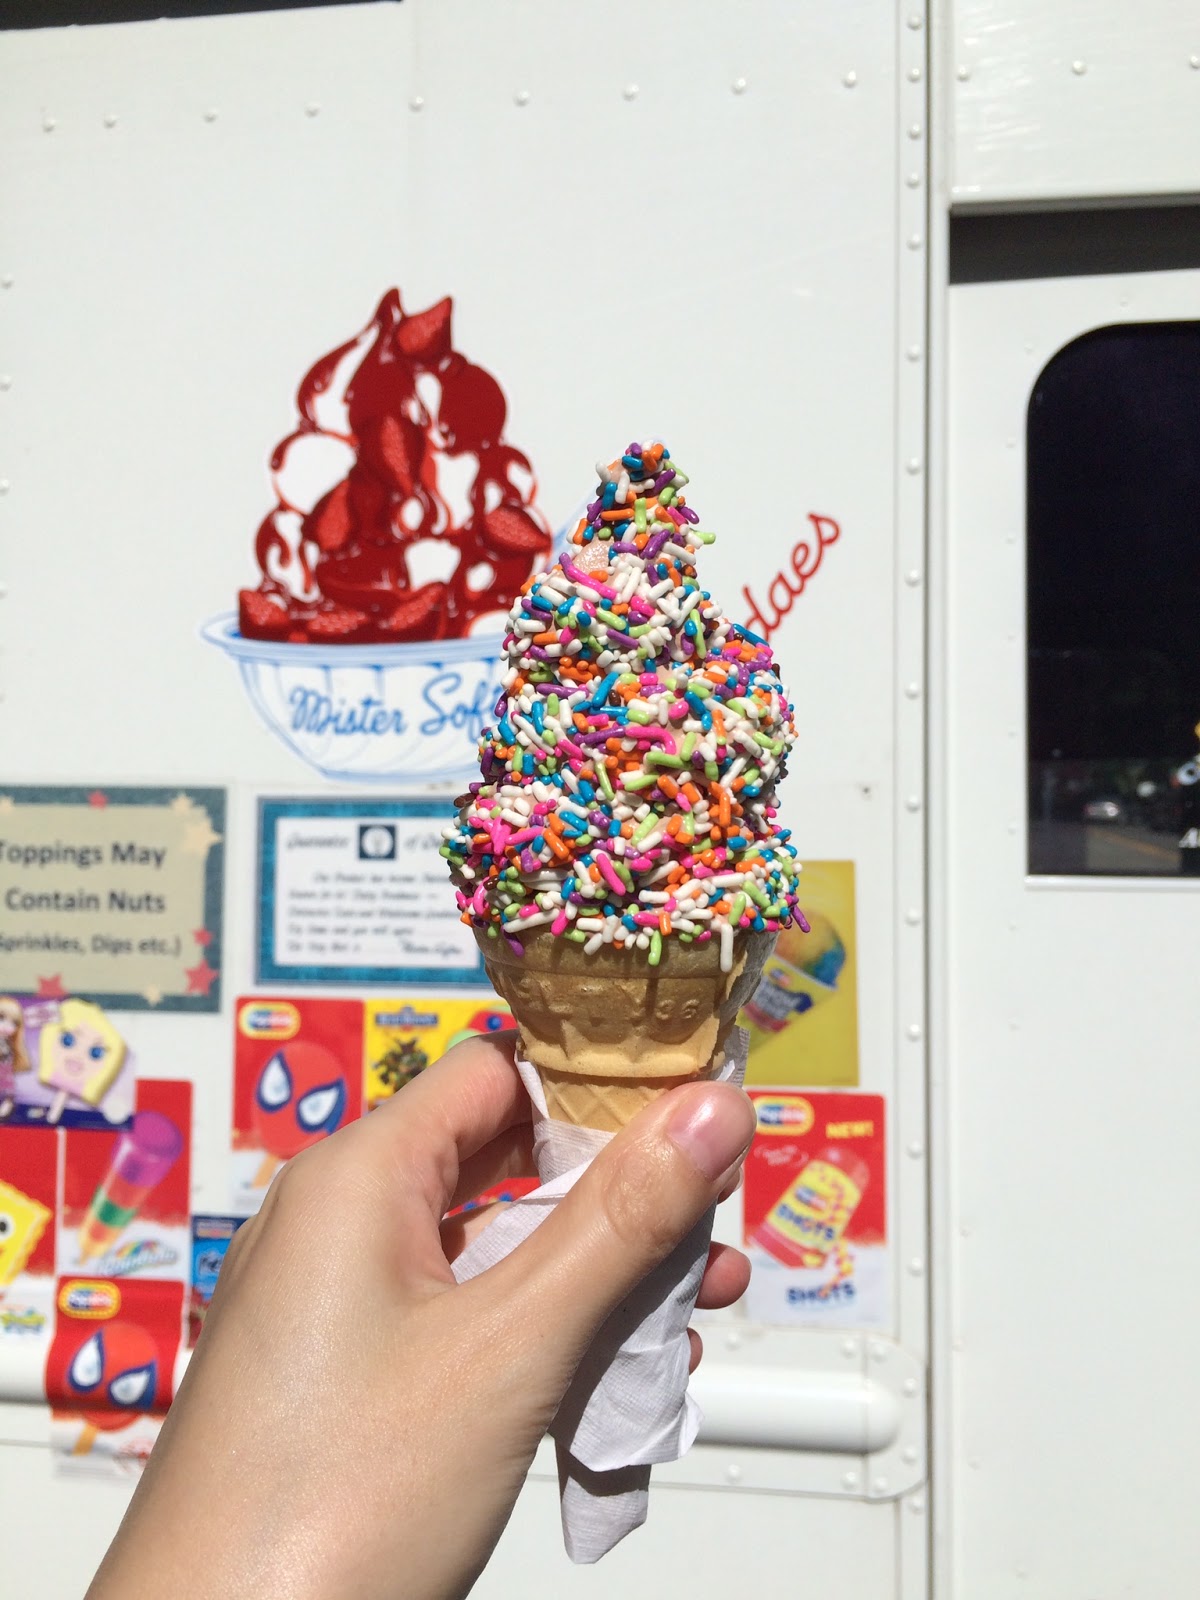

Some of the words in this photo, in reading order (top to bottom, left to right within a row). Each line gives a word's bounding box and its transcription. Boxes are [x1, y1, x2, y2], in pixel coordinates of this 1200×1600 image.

[290, 685, 406, 735] Mister
[111, 842, 167, 870] May
[5, 888, 100, 911] Contain
[108, 891, 165, 913] Nuts
[91, 934, 132, 957] Dips
[826, 1121, 874, 1139] NEW!
